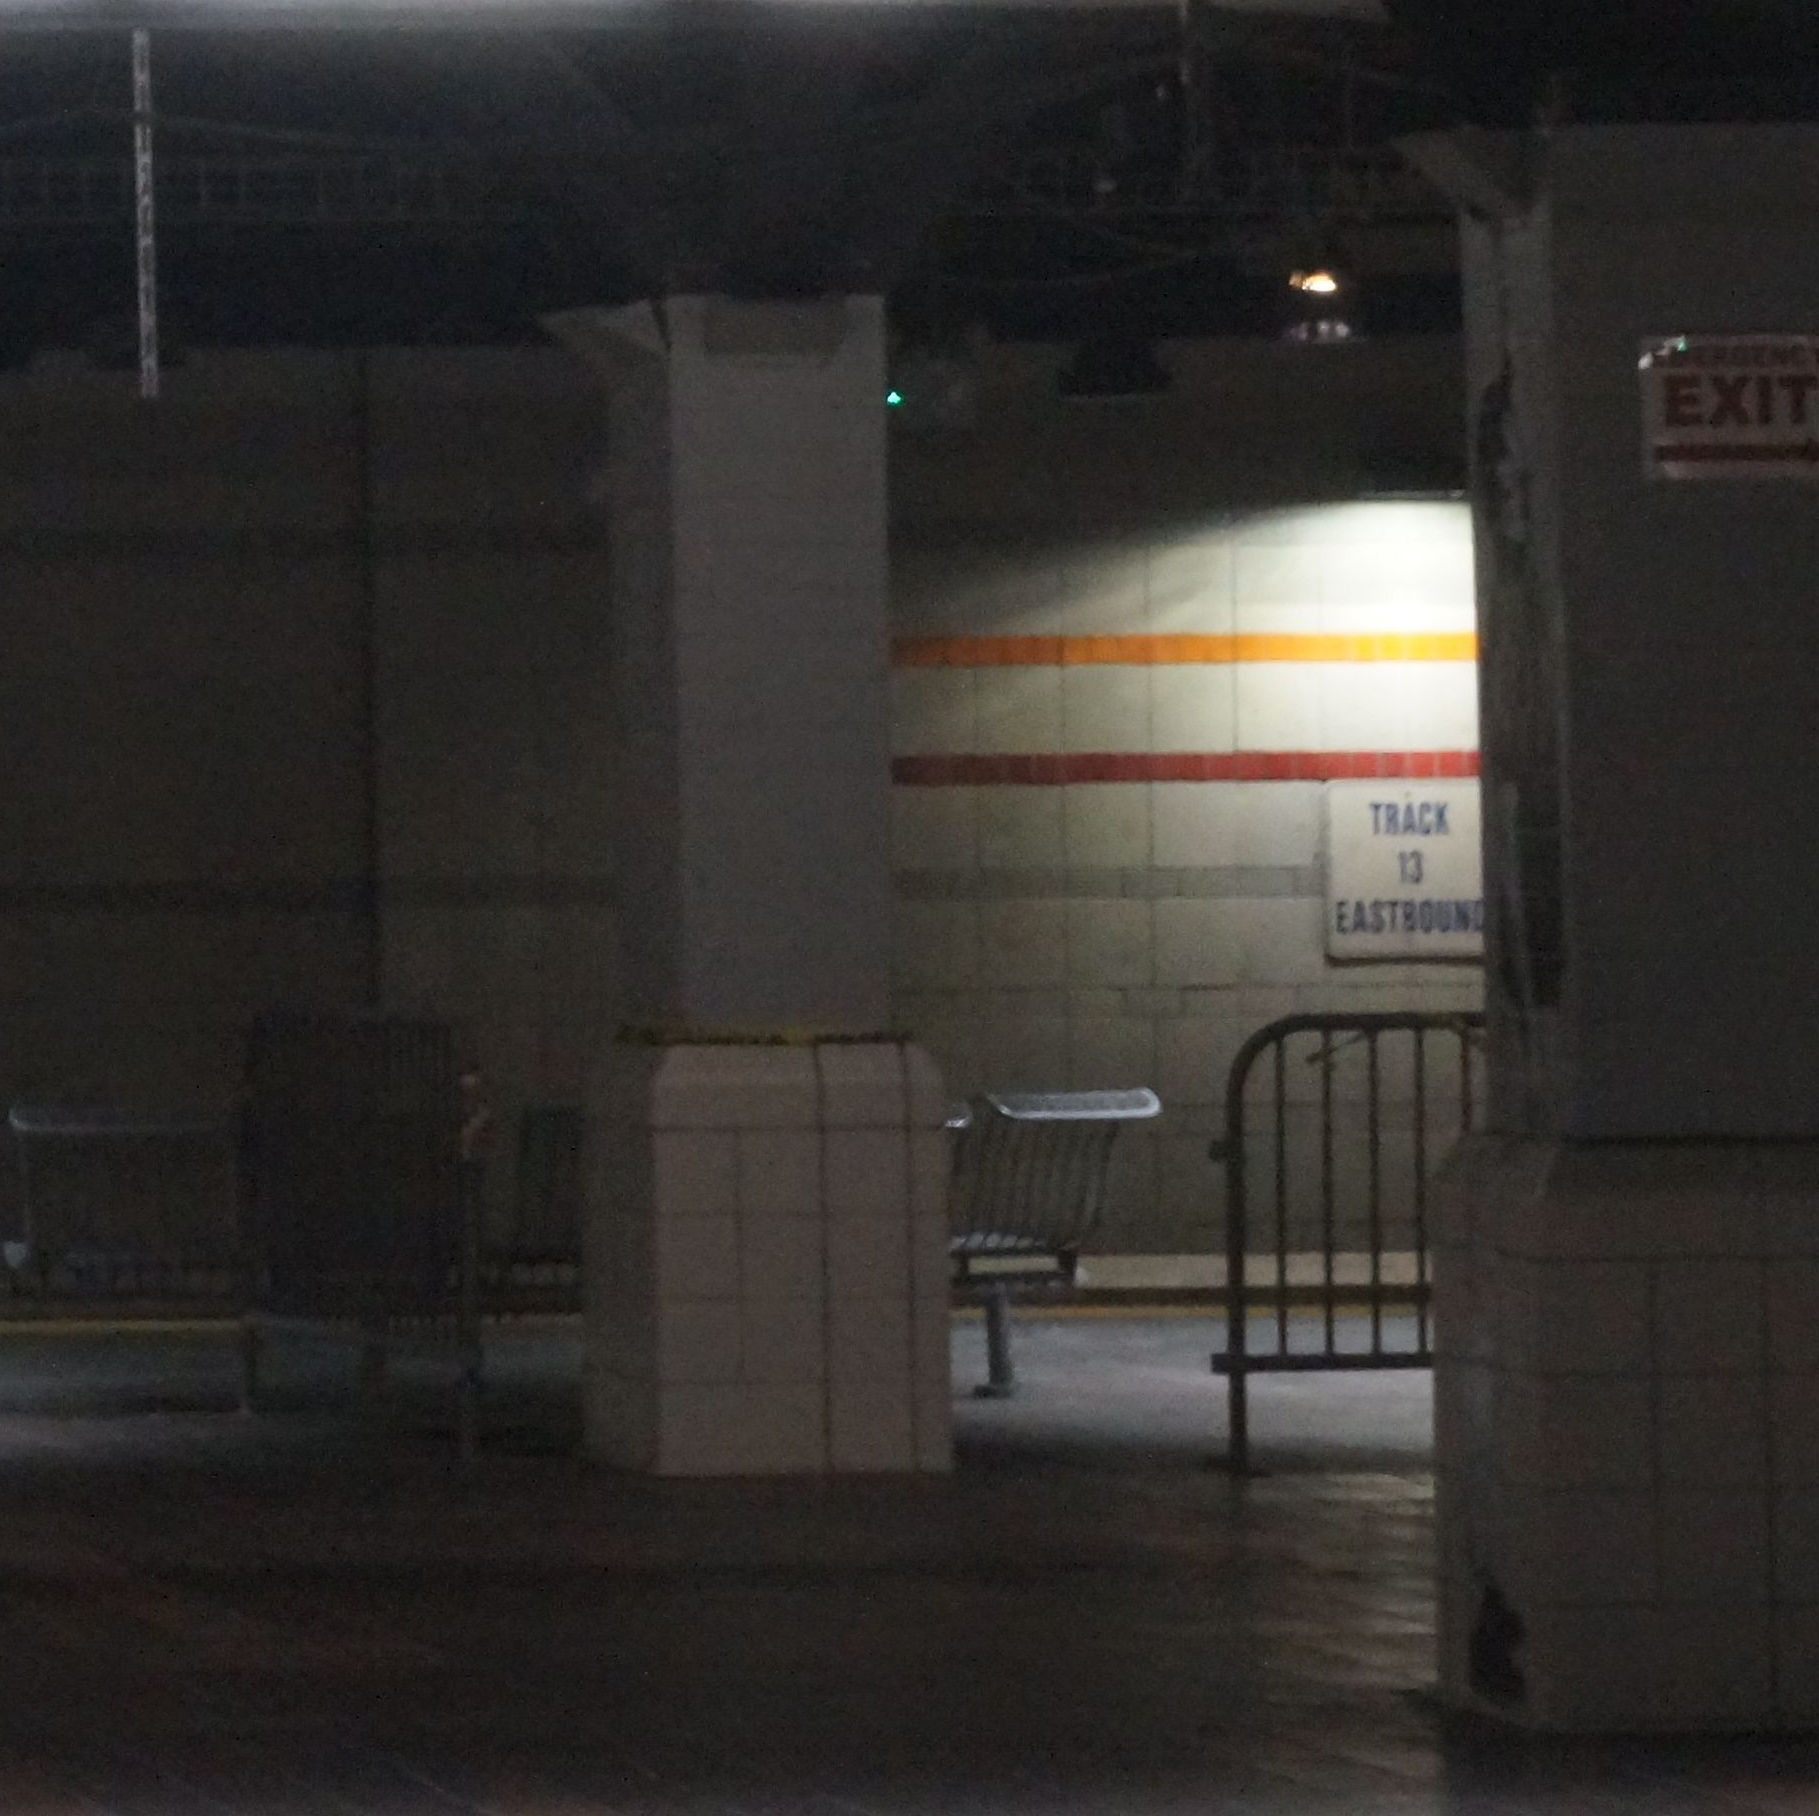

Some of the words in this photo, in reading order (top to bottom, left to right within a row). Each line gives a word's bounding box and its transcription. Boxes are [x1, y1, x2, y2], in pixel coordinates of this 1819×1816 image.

[1664, 375, 1819, 427] EXIT
[1370, 802, 1449, 836] TRACK
[1399, 851, 1423, 885] 13
